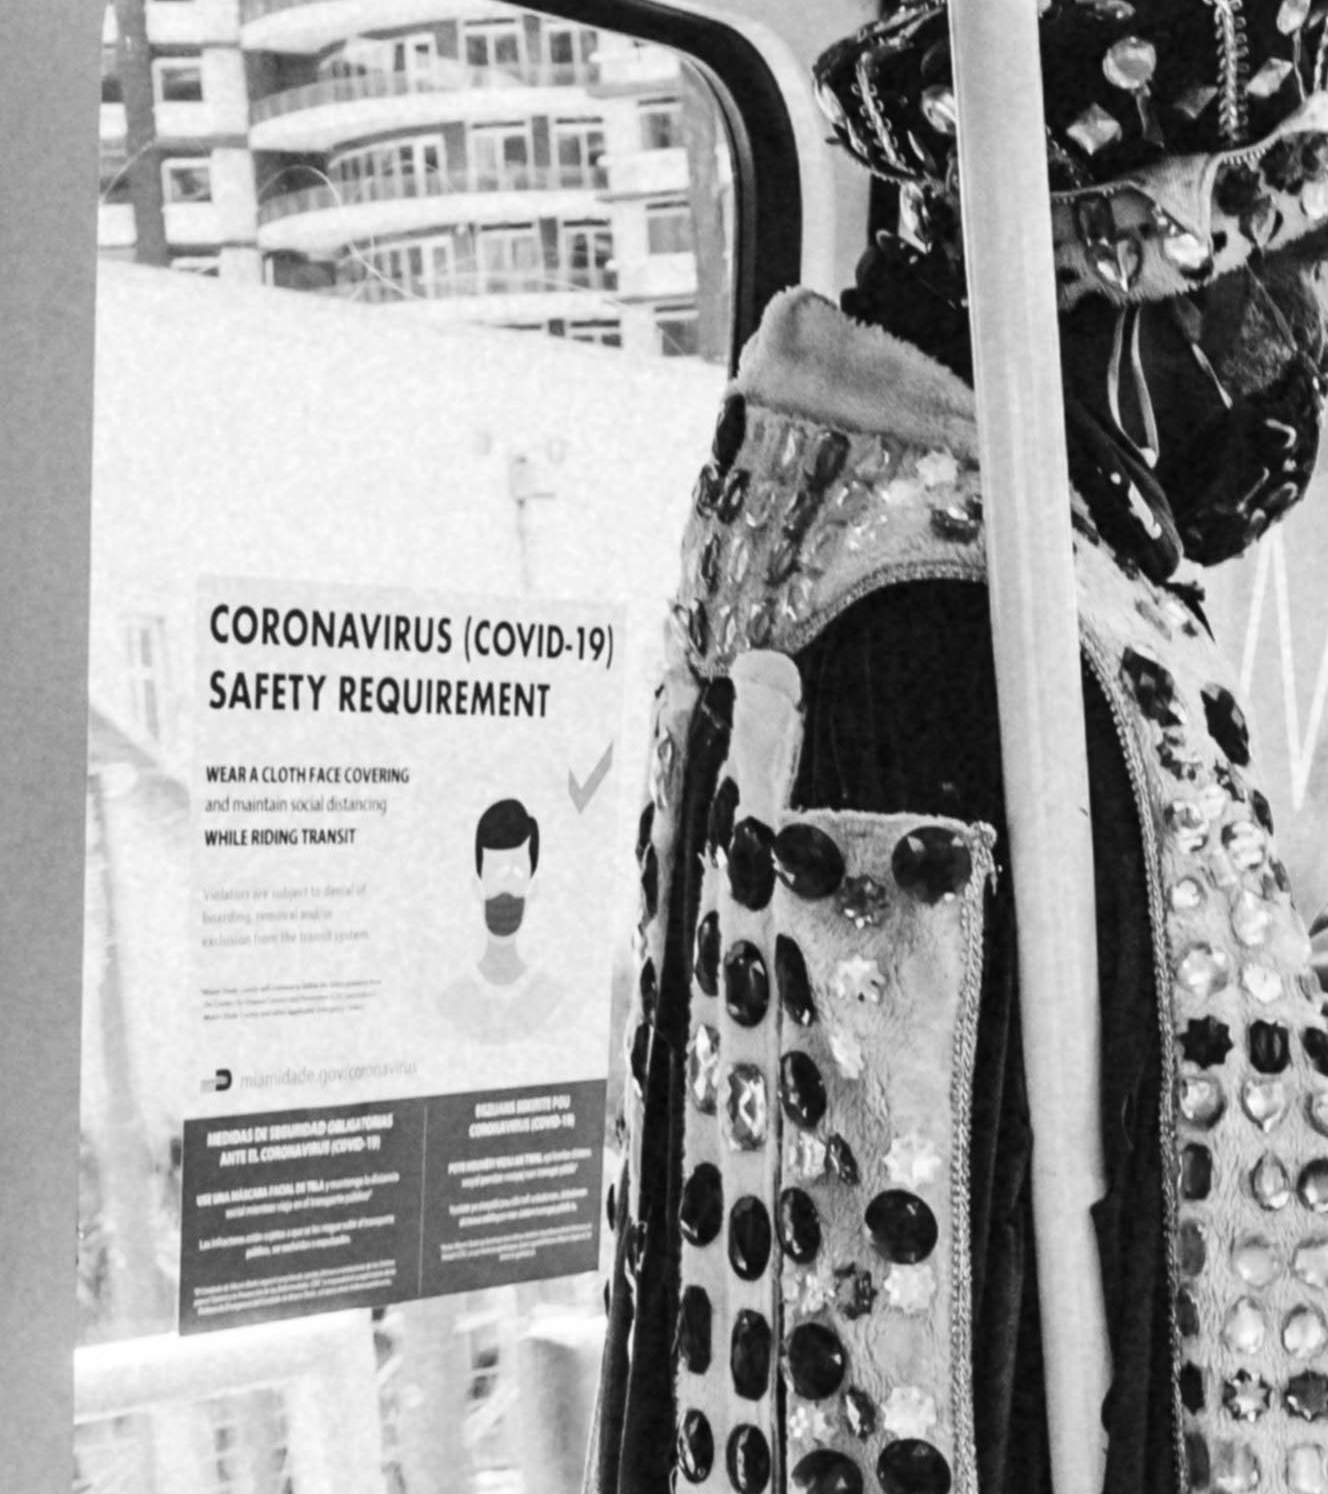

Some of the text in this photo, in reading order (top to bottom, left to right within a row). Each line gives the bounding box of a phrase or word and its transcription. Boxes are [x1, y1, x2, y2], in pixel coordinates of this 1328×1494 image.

[210, 603, 614, 670] CORONAVIRUS (COVID-19)
[209, 669, 551, 718] SAFETY REQUIREMENT
[206, 765, 410, 784] WEAR A CLOTH FACE COVERING
[205, 795, 387, 816] and maintain social distancing
[205, 828, 356, 846] WHILE RIDING TRANSIT
